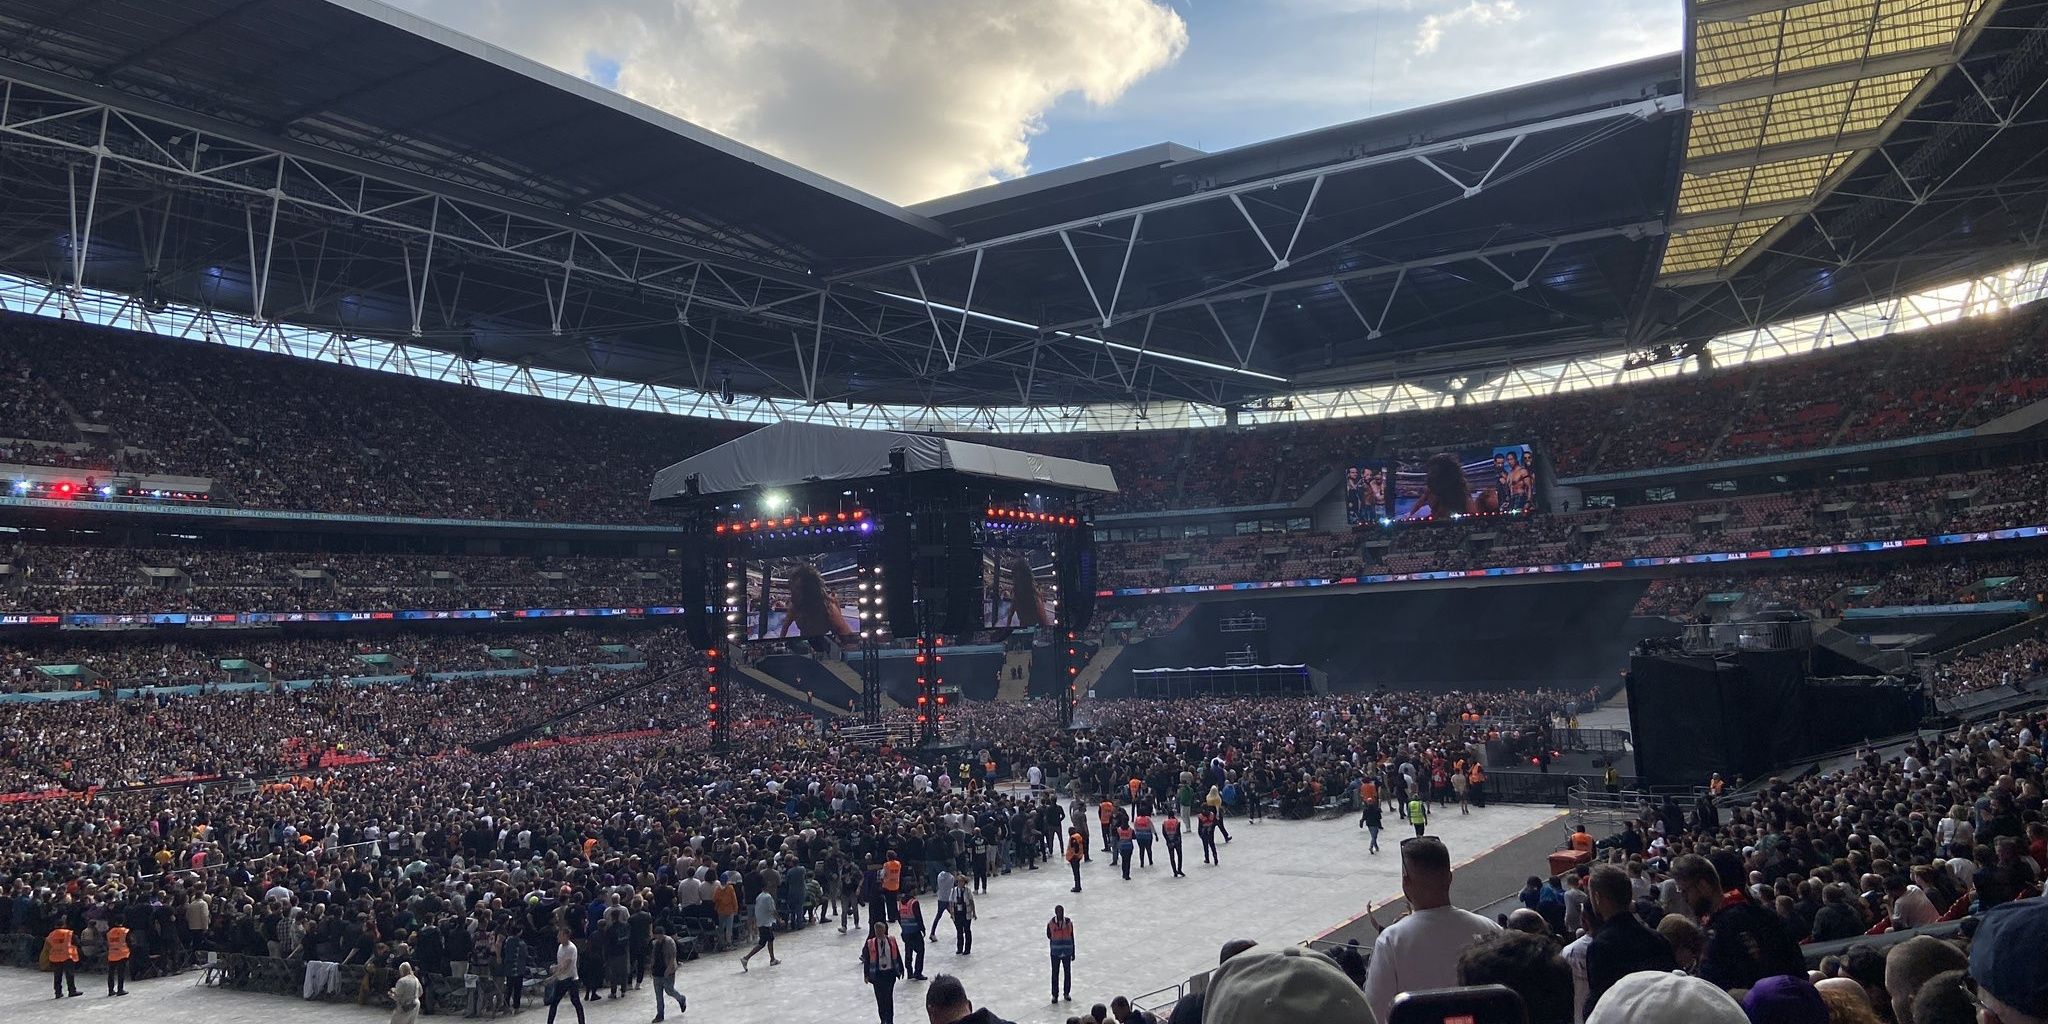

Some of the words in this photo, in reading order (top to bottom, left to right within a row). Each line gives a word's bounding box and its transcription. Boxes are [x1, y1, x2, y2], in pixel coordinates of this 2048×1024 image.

[136, 505, 168, 513] WEMBLEY
[170, 507, 208, 515] CONNECTED
[233, 510, 264, 518] WEMBLEY
[265, 511, 301, 519] CONNECTED
